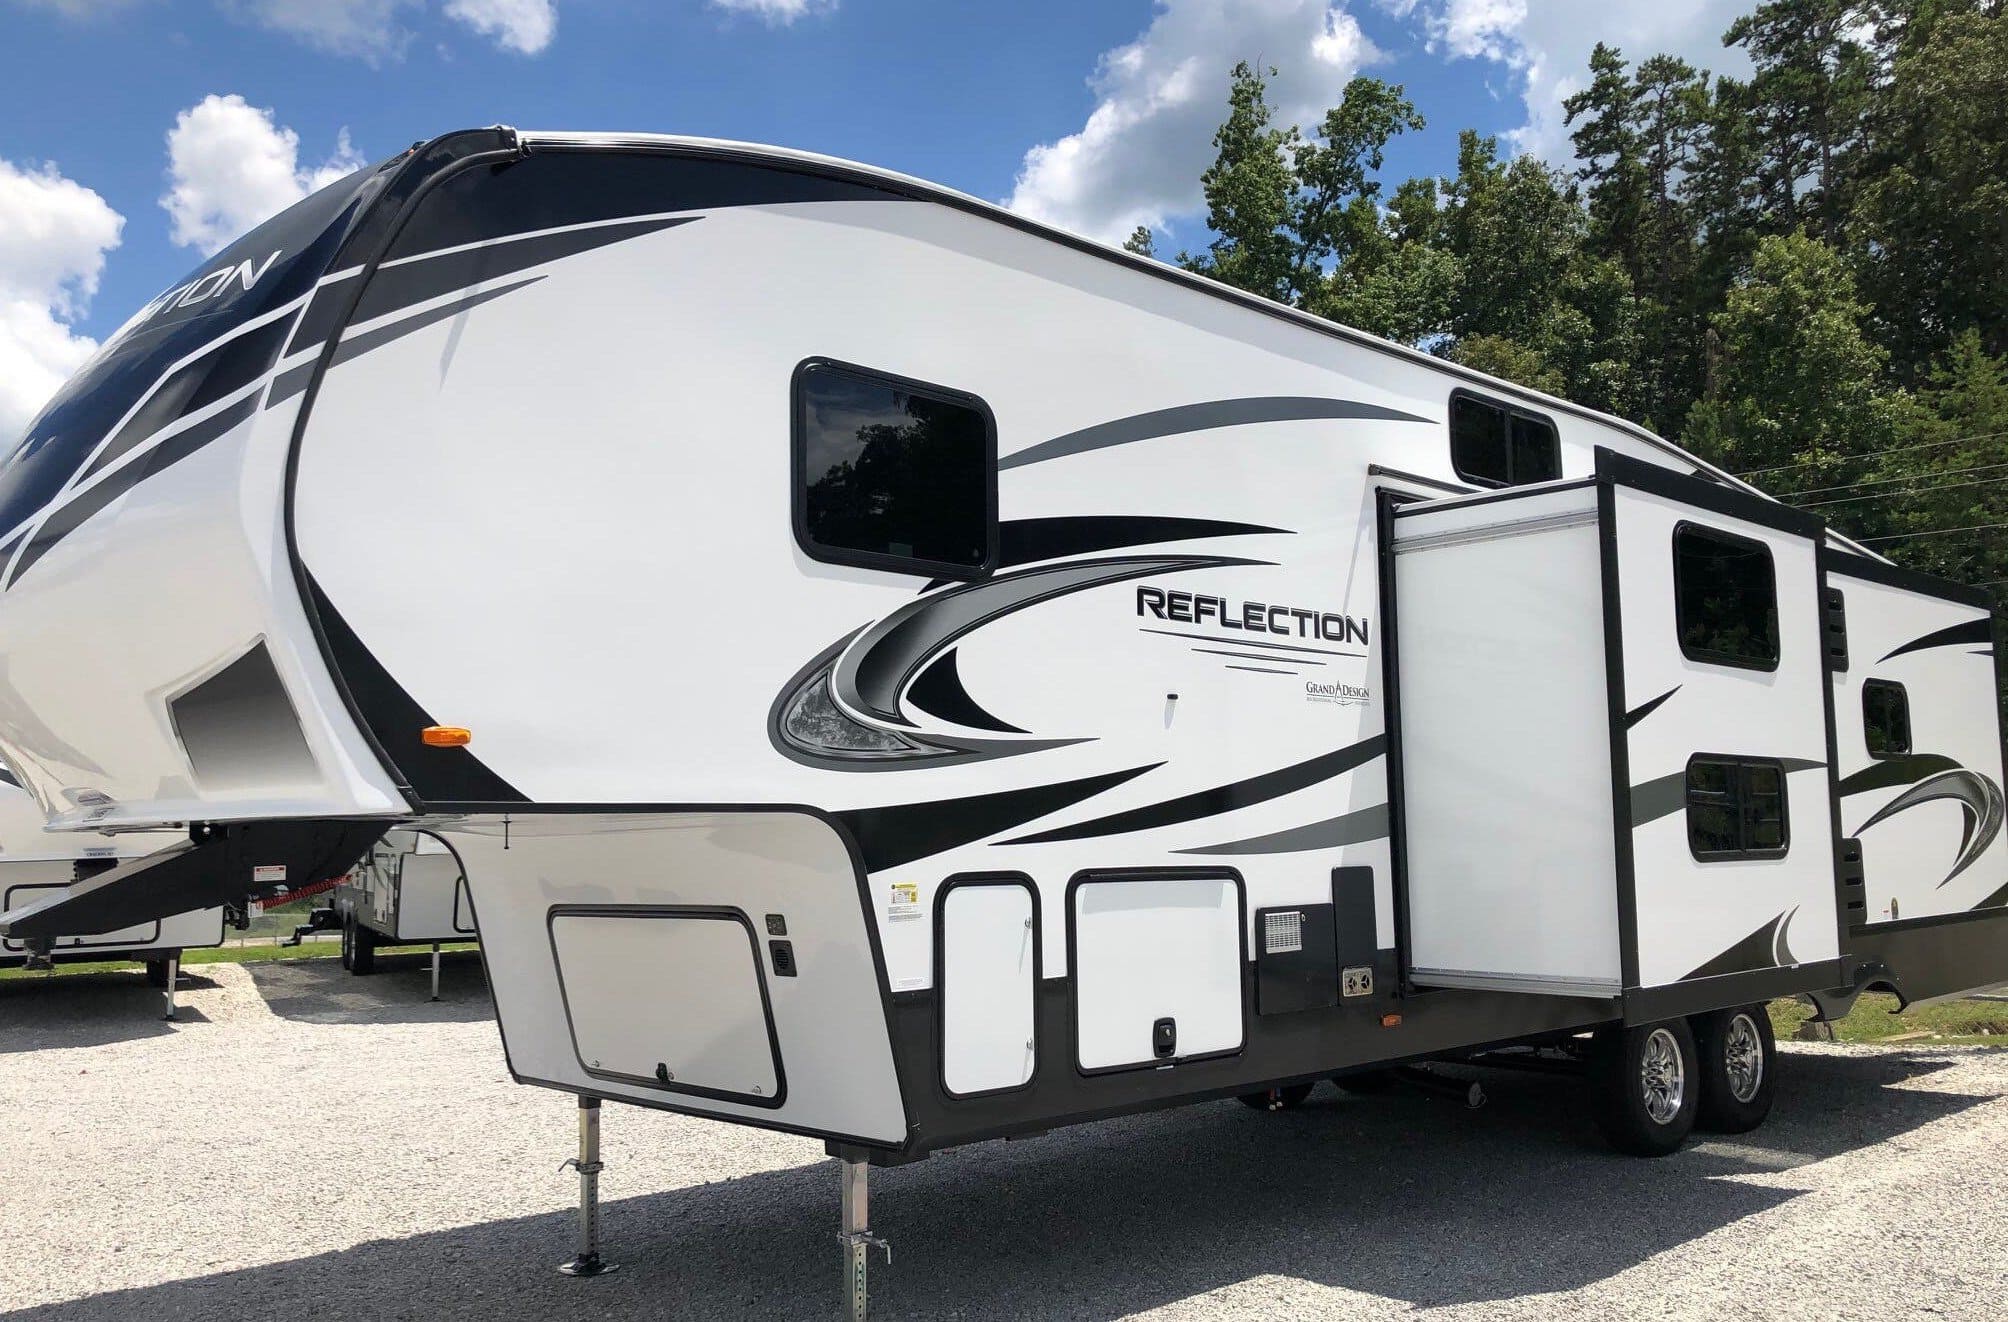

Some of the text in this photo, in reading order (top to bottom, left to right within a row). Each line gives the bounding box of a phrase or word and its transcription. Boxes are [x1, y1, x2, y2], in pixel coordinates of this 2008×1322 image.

[140, 249, 283, 325] TION
[1136, 585, 1369, 646] REFLECTION
[1306, 681, 1370, 698] GRAND DESIGN
